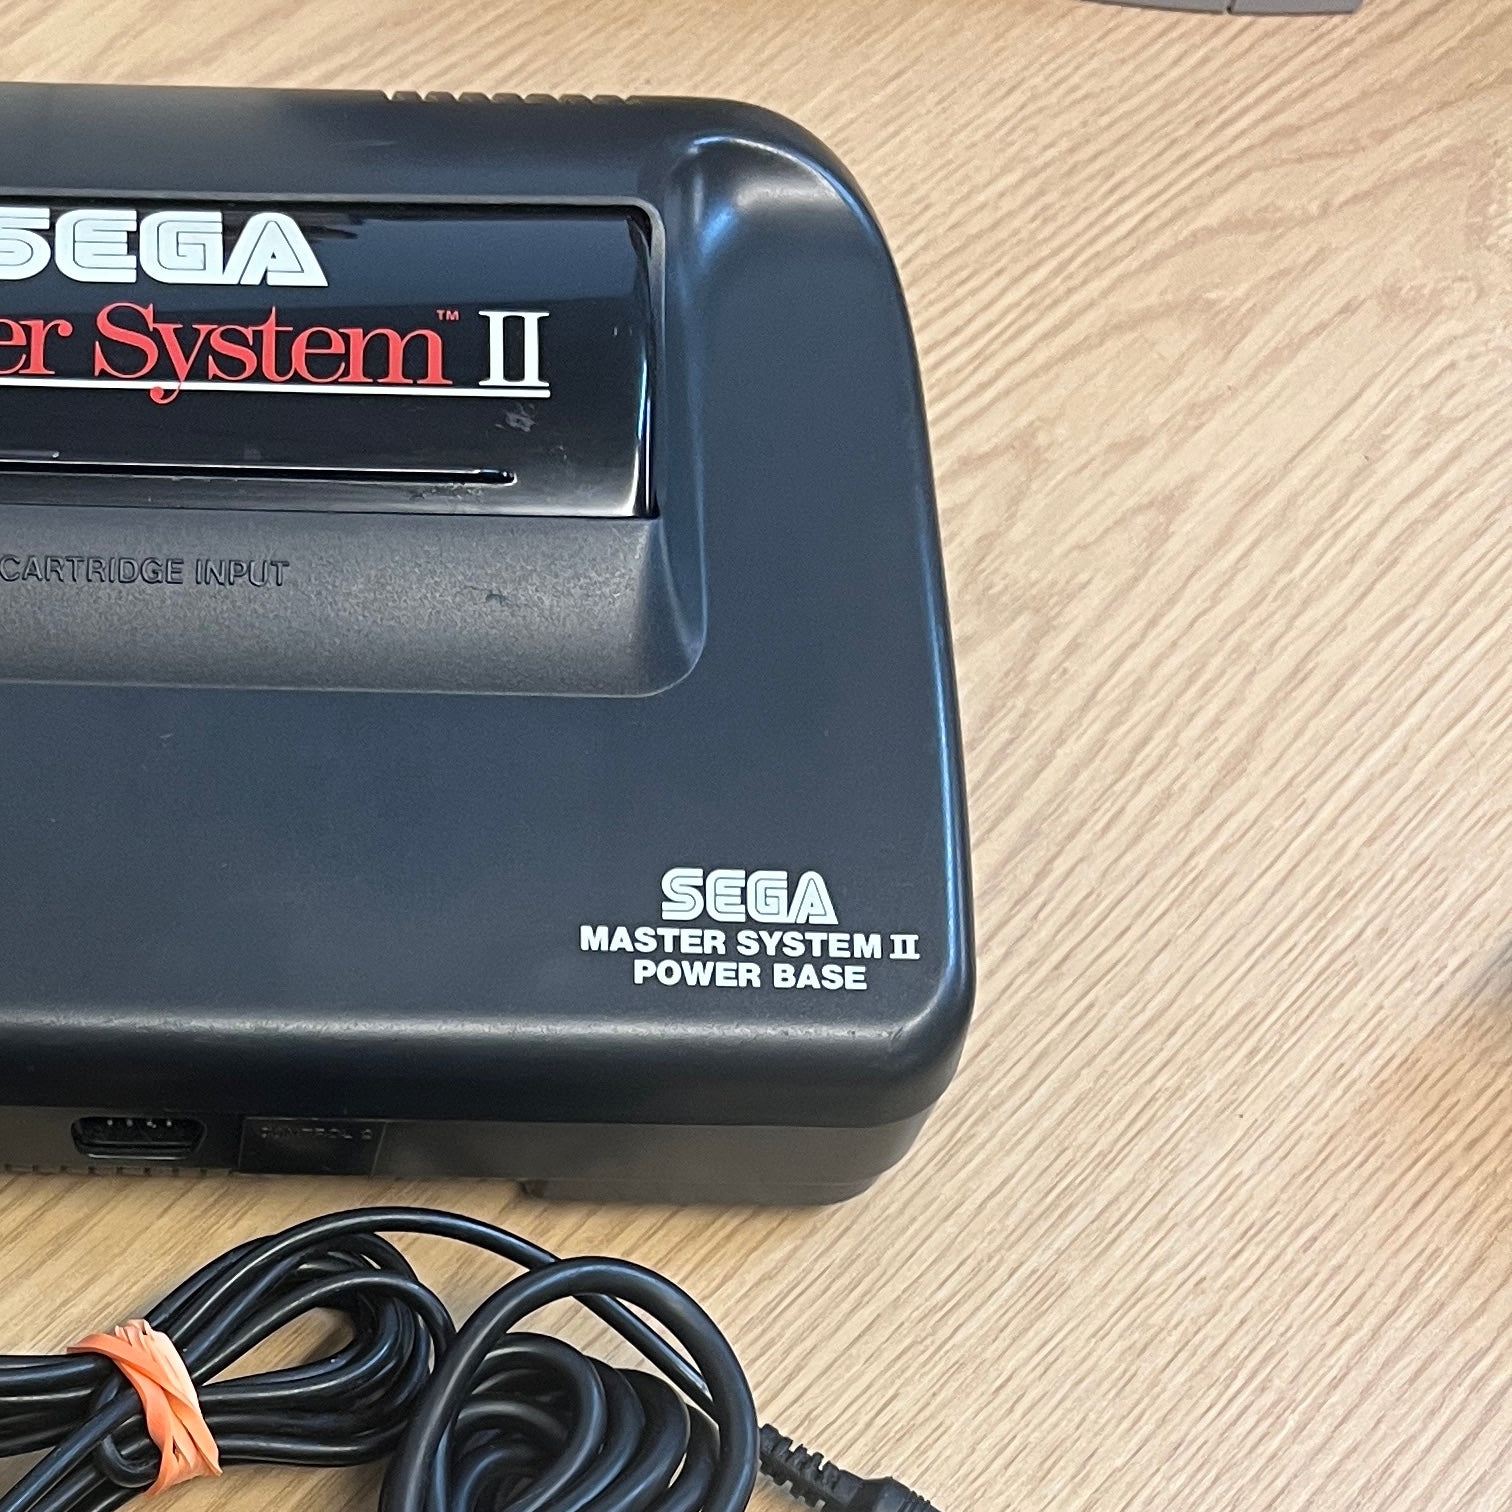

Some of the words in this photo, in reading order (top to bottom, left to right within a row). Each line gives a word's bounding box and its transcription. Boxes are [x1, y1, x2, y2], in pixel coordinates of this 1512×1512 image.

[93, 302, 453, 404] System
[478, 311, 551, 387] II
[194, 558, 289, 587] INPUT
[661, 867, 840, 925] SEGA
[580, 925, 726, 955] MASTER
[736, 929, 883, 959] SYSTEM
[889, 934, 921, 960] II
[633, 960, 761, 988] POWER
[773, 963, 868, 990] BASE
